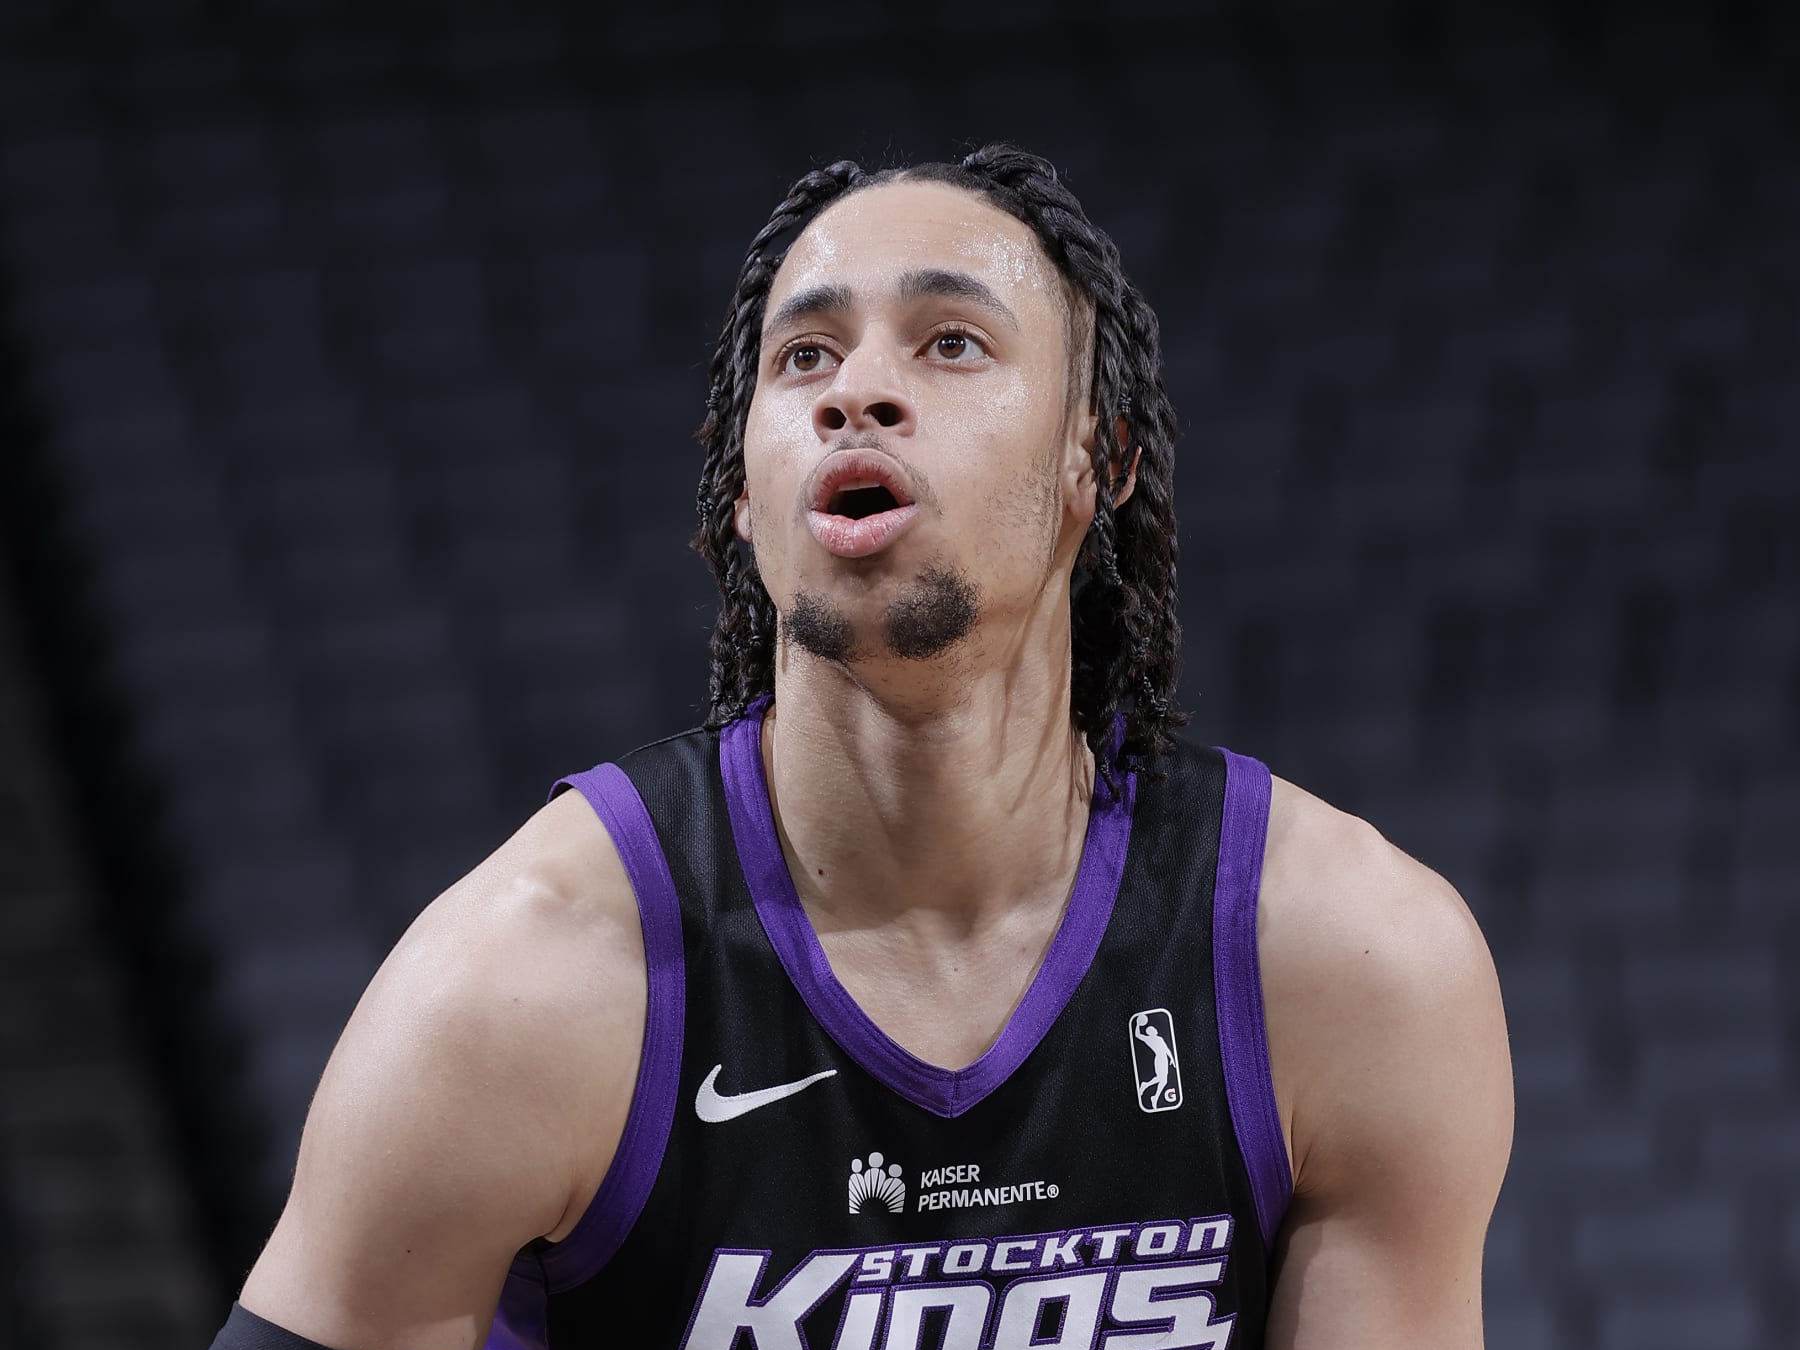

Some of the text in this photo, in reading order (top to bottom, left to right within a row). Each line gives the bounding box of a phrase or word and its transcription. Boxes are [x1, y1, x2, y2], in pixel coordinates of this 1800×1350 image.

[1164, 1088, 1177, 1103] G
[920, 1164, 981, 1189] KAISER
[854, 1214, 1233, 1284] STOCKTON
